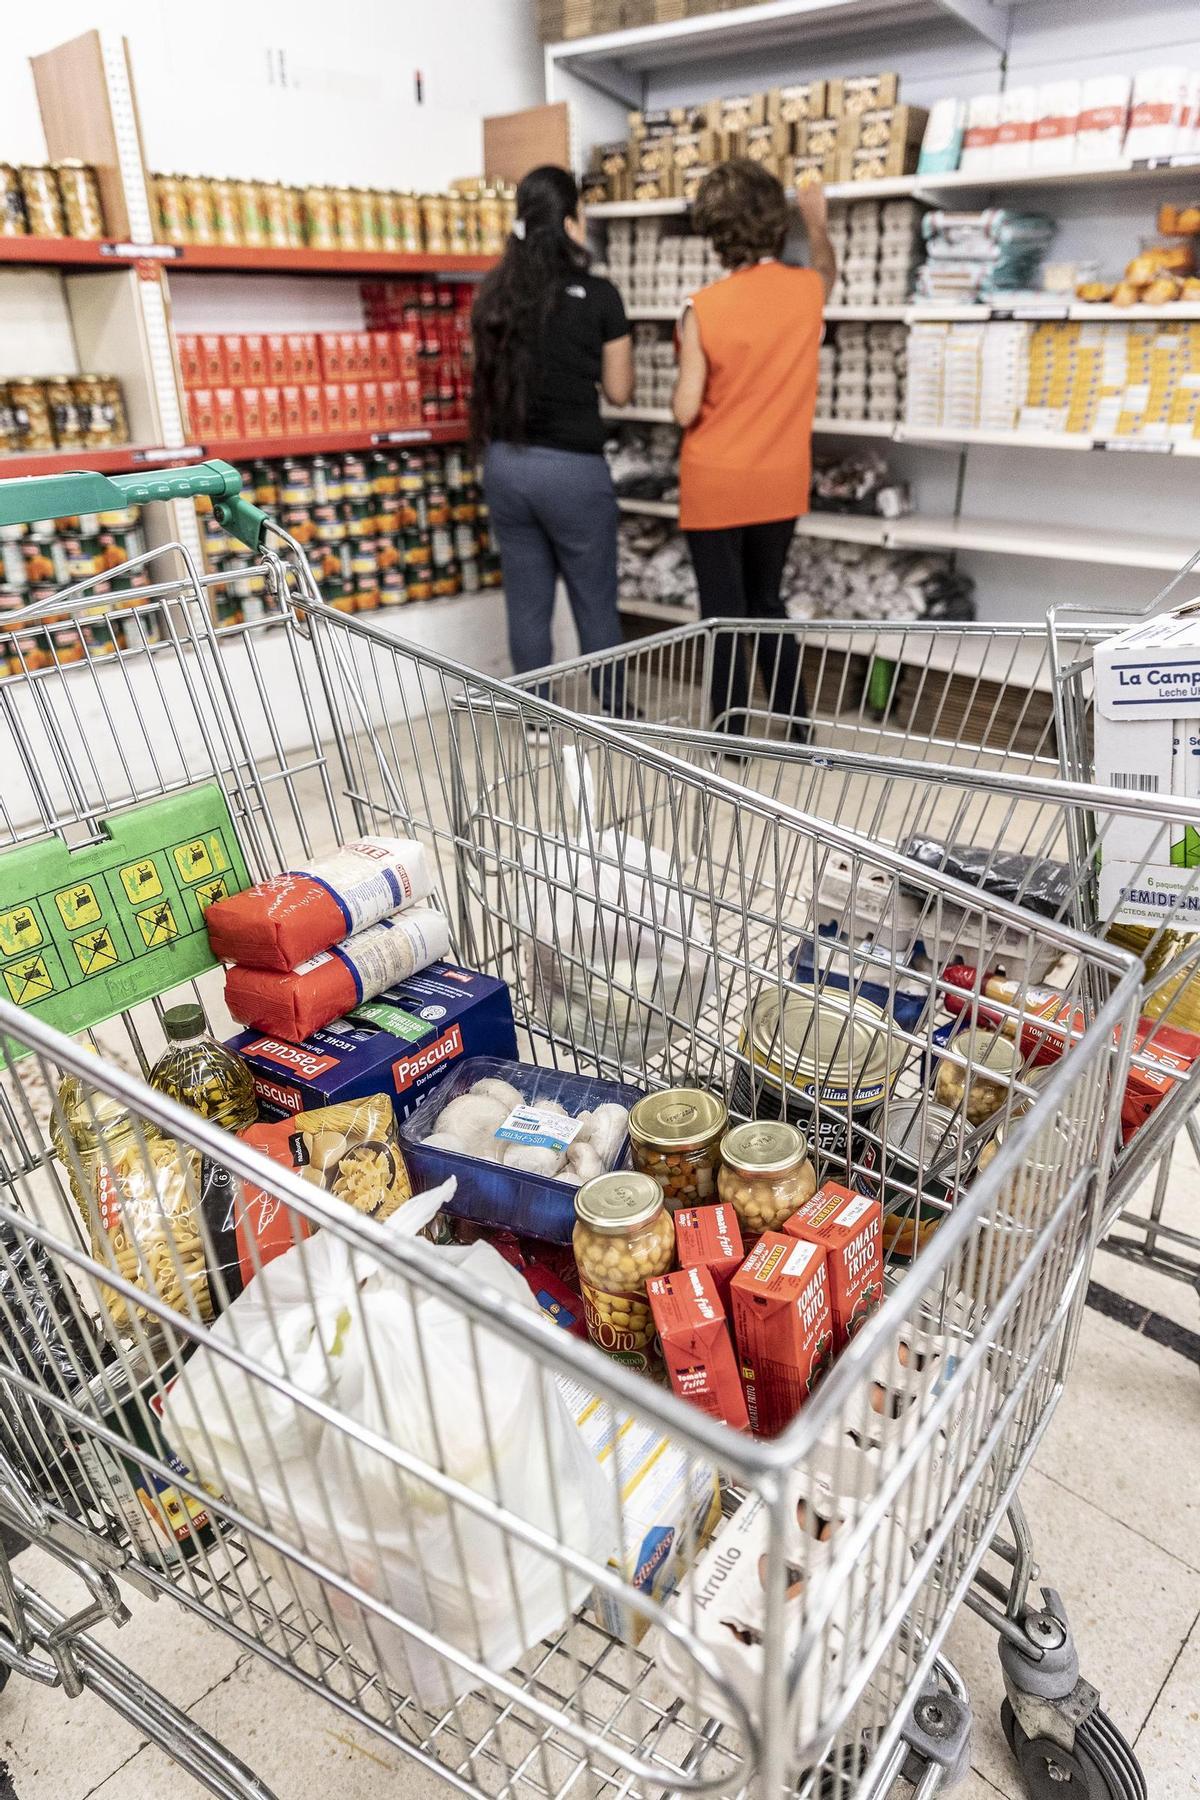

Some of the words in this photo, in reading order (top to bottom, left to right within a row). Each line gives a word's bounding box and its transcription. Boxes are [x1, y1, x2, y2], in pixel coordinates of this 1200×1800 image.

[1120, 671, 1142, 686] La
[1159, 688, 1188, 698] Leche
[1147, 876, 1154, 886] 6
[1155, 881, 1185, 891] paquete
[324, 1036, 357, 1052] LECHE
[1028, 1026, 1053, 1043] TOMTE
[250, 1039, 327, 1075] Pascual
[398, 1030, 459, 1083] Pascual
[416, 1076, 427, 1087] Dar
[432, 1062, 448, 1076] mejor
[254, 1080, 300, 1111] ascual
[808, 1085, 848, 1100] Gllina
[850, 1086, 881, 1100] lanca
[714, 1206, 728, 1235] Tomate
[812, 1196, 842, 1227] GARBAYO
[716, 1235, 733, 1257] frito
[842, 1216, 879, 1265] TOMATE
[759, 1247, 784, 1279] GARBAYO
[848, 1241, 875, 1281] FRITO
[688, 1268, 704, 1297] Tomate
[797, 1262, 827, 1318] TOMATE
[693, 1298, 715, 1319] frito
[803, 1288, 825, 1333] FRITO
[598, 1322, 635, 1351] Oro
[677, 1370, 707, 1382] Tomate
[682, 1379, 706, 1391] frito
[746, 1384, 757, 1404] FRITO
[693, 1547, 742, 1611] Arrullo
